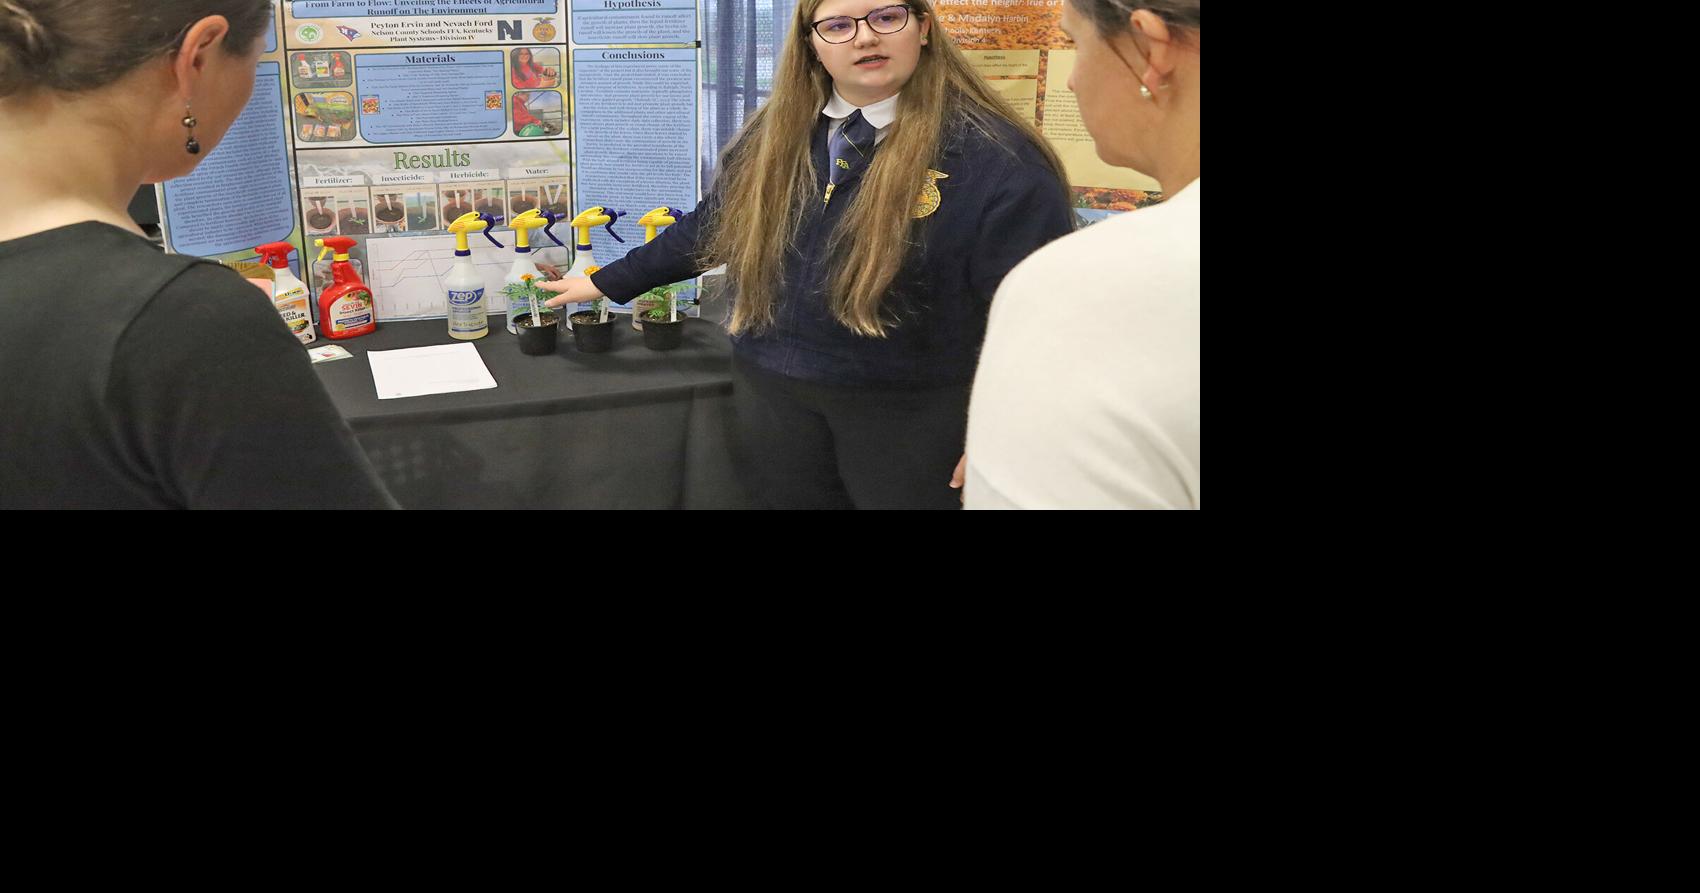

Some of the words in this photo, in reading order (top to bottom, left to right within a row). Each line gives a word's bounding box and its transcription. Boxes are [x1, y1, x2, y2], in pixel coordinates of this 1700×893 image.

[332, 0, 354, 8] Farm
[604, 0, 662, 10] Hypothesis
[405, 54, 456, 64] Materials
[602, 50, 665, 60] Conclusions
[394, 148, 470, 170] Results
[315, 176, 353, 184] Fertilizer:
[381, 174, 425, 182] Insecticide:
[450, 172, 489, 180] Herbicide:
